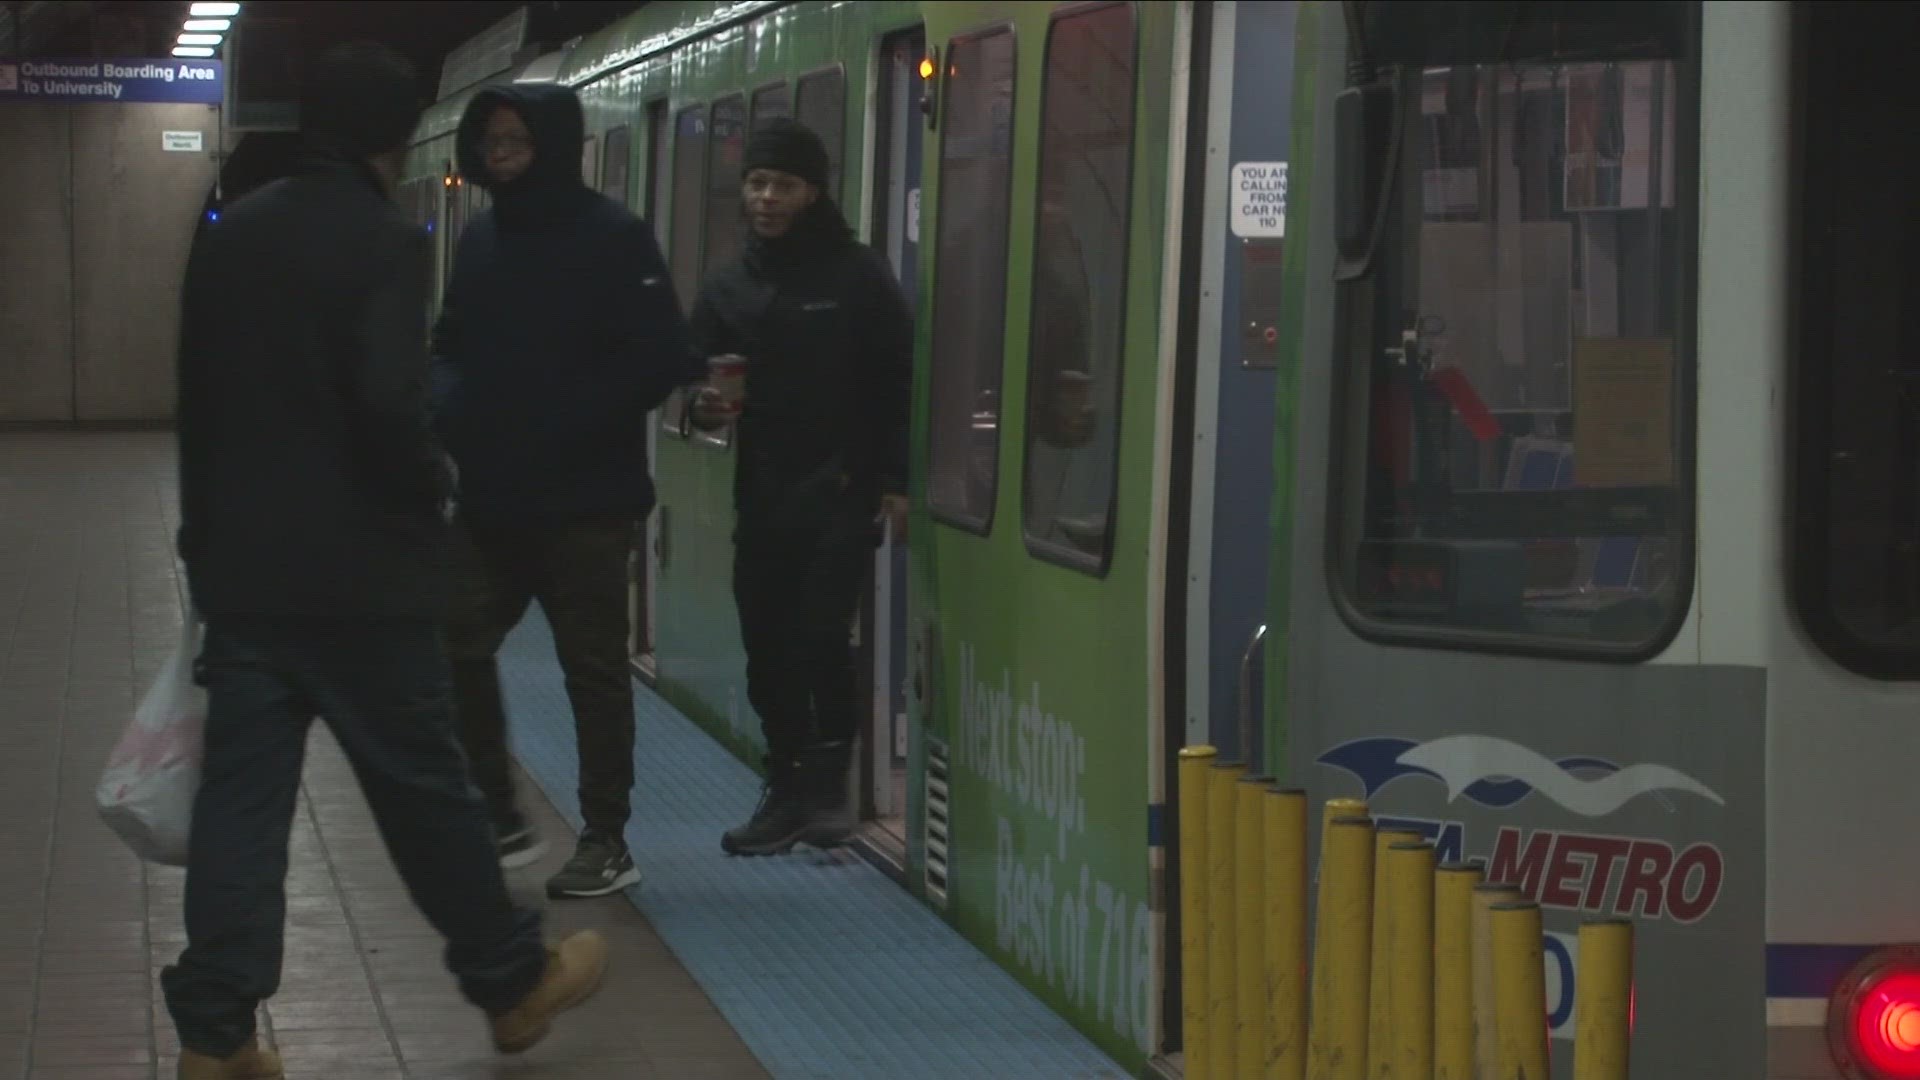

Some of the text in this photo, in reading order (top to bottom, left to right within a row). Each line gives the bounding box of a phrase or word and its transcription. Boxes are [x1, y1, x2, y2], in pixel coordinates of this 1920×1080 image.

[21, 63, 215, 82] Outbound Boarding Area
[22, 80, 123, 98] To University
[1240, 167, 1266, 179] YOU
[1240, 180, 1287, 191] CALLIN
[1250, 193, 1287, 203] FROM
[1242, 205, 1268, 216] CAR
[1259, 217, 1277, 228] 110
[957, 640, 1085, 865] Next stop:
[995, 814, 1150, 1052] Best of 716
